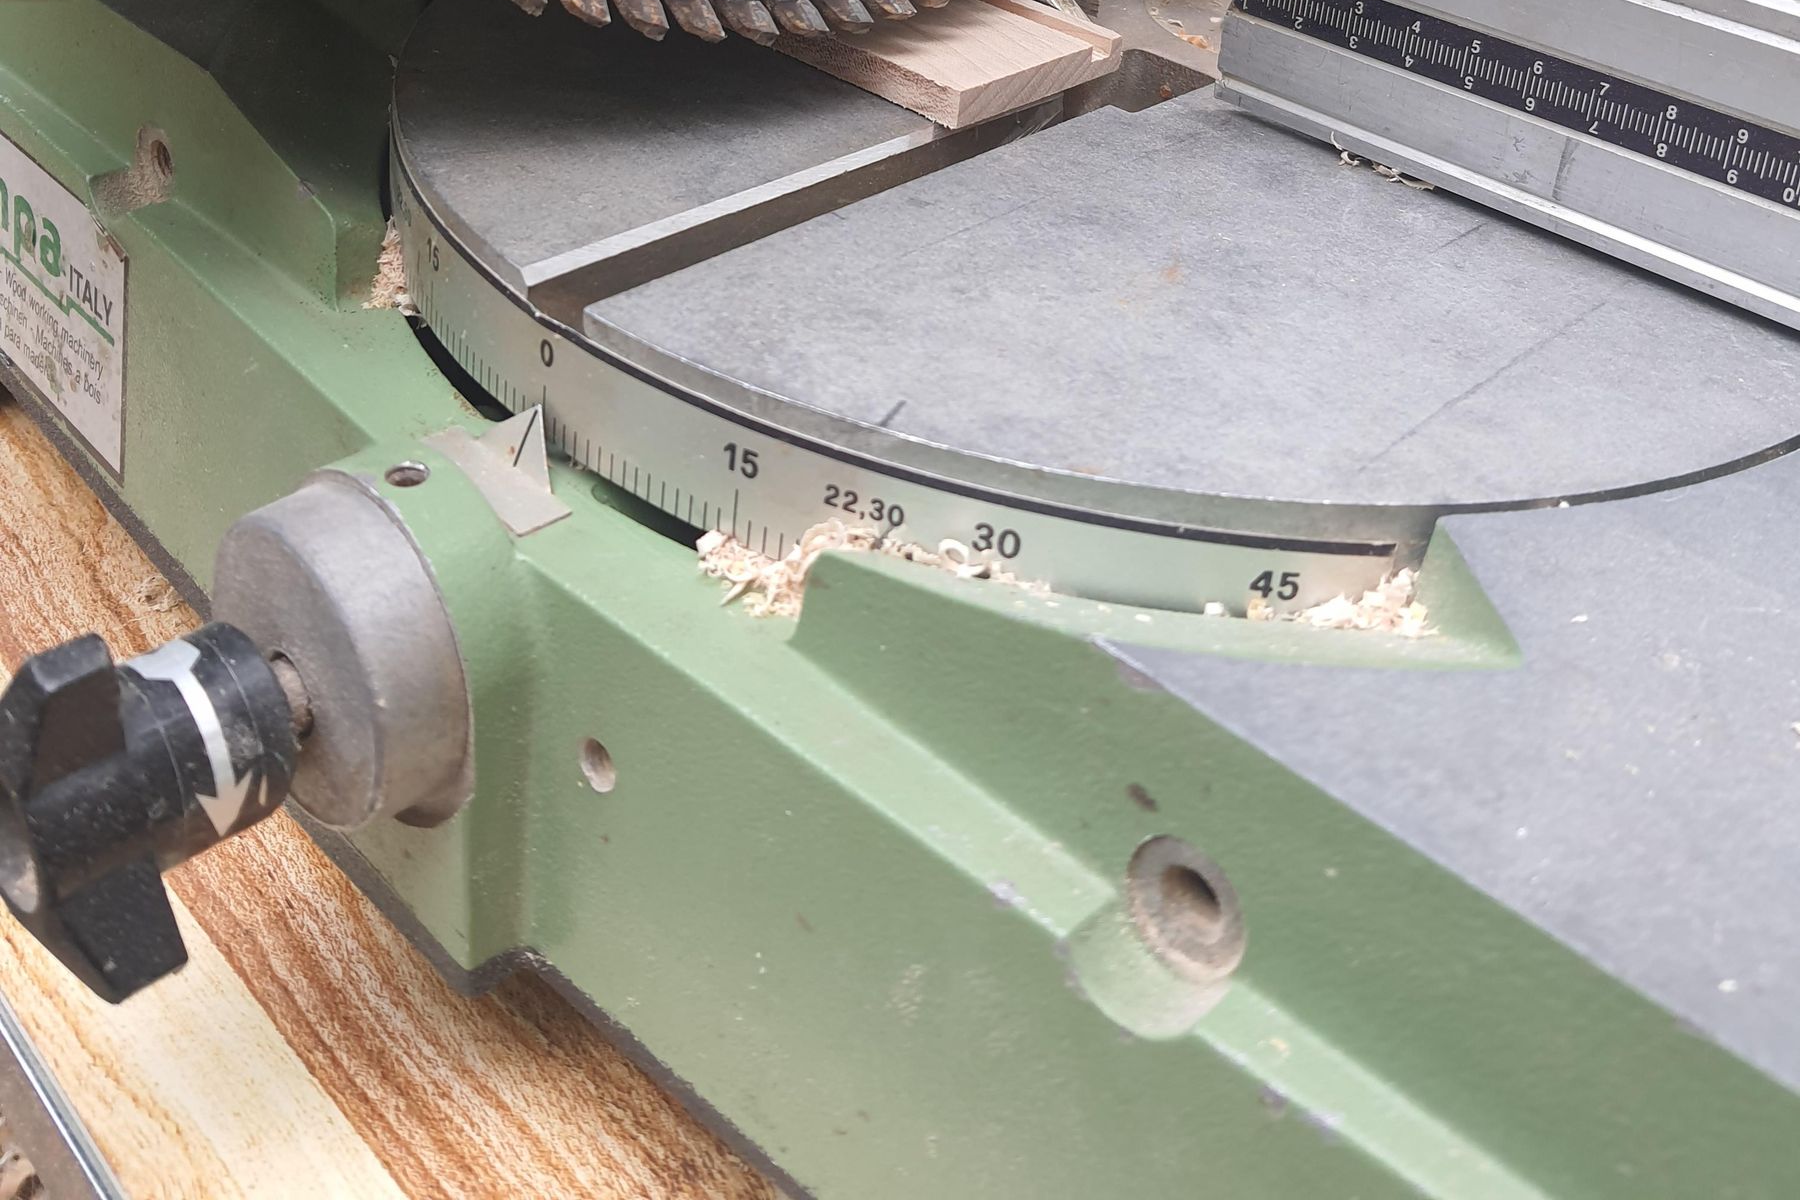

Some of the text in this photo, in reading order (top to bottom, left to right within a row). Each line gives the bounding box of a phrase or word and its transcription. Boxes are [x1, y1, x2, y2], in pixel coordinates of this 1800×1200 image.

[1294, 16, 1302, 30] 2
[1349, 35, 1358, 49] 3
[1404, 54, 1414, 68] 4
[1464, 76, 1474, 90] 5
[1588, 120, 1598, 135] 7
[1656, 143, 1667, 157] 8
[1355, 1, 1364, 15] 3
[1411, 20, 1421, 34] 4
[1470, 40, 1481, 53] 5
[1533, 61, 1543, 75] 6
[1600, 82, 1610, 96] 7
[1666, 105, 1677, 120] 8
[1736, 128, 1749, 144] 9
[427, 237, 440, 272] 15
[69, 264, 113, 327] ITALY
[4, 324, 21, 350] para
[5, 266, 104, 380] Wood working machinery
[35, 325, 73, 376] Machines
[75, 369, 81, 384] a
[84, 373, 101, 404] bois
[540, 339, 553, 367] 0
[723, 442, 759, 479] 15
[823, 484, 905, 528] 22,30
[971, 522, 1022, 560] 30
[1248, 569, 1300, 602] 45
